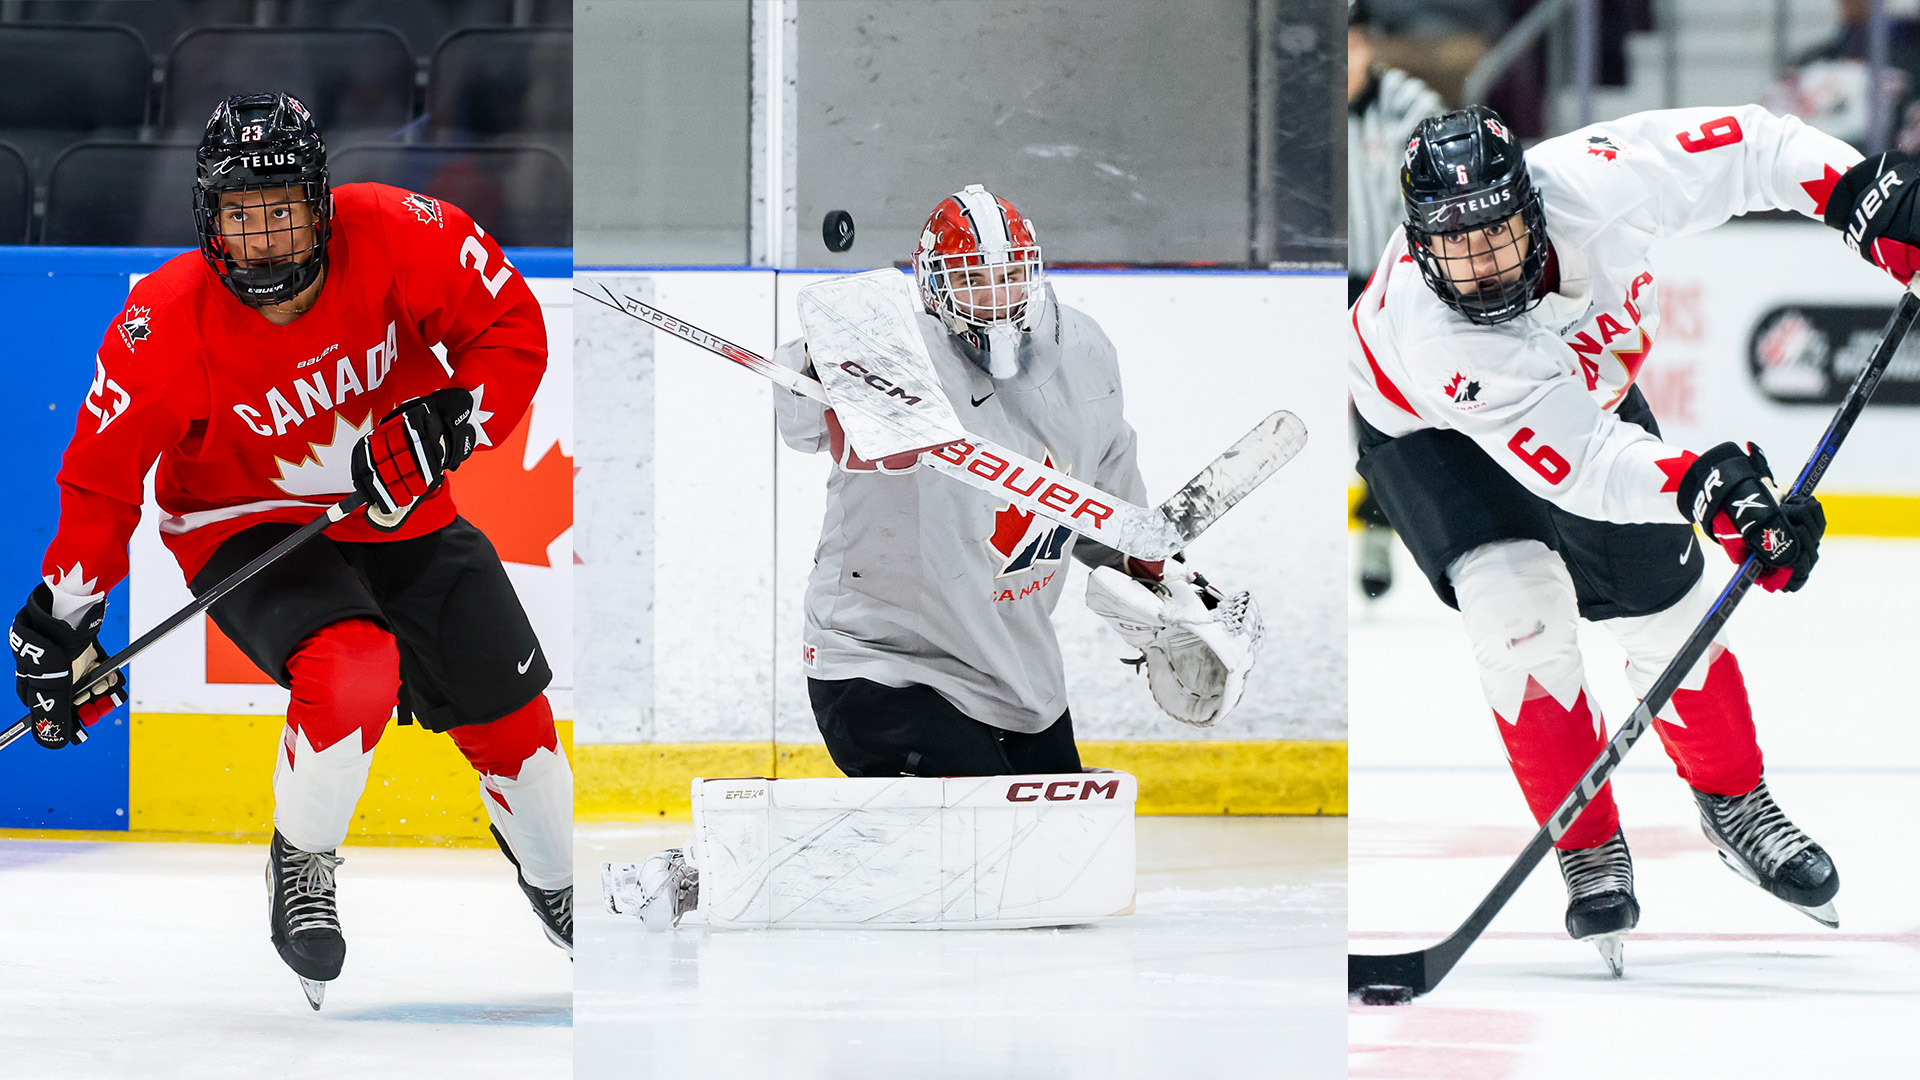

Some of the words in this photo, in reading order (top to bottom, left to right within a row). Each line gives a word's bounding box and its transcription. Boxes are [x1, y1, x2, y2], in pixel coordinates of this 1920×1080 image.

[241, 125, 262, 142] 23
[1676, 116, 1743, 153] 6
[241, 153, 296, 168] TELUS
[1456, 164, 1469, 185] 6
[1456, 189, 1511, 214] TELUS
[459, 221, 515, 299] 2
[117, 324, 135, 353] CANADA
[85, 352, 131, 434] 23
[233, 320, 398, 436] CANADA
[840, 361, 922, 406] CCM
[1507, 427, 1571, 485] 6
[1802, 453, 1830, 497] RIGGER
[993, 570, 1056, 603] ANAD
[1548, 701, 1653, 842] CCM
[1006, 780, 1120, 802] CCM
